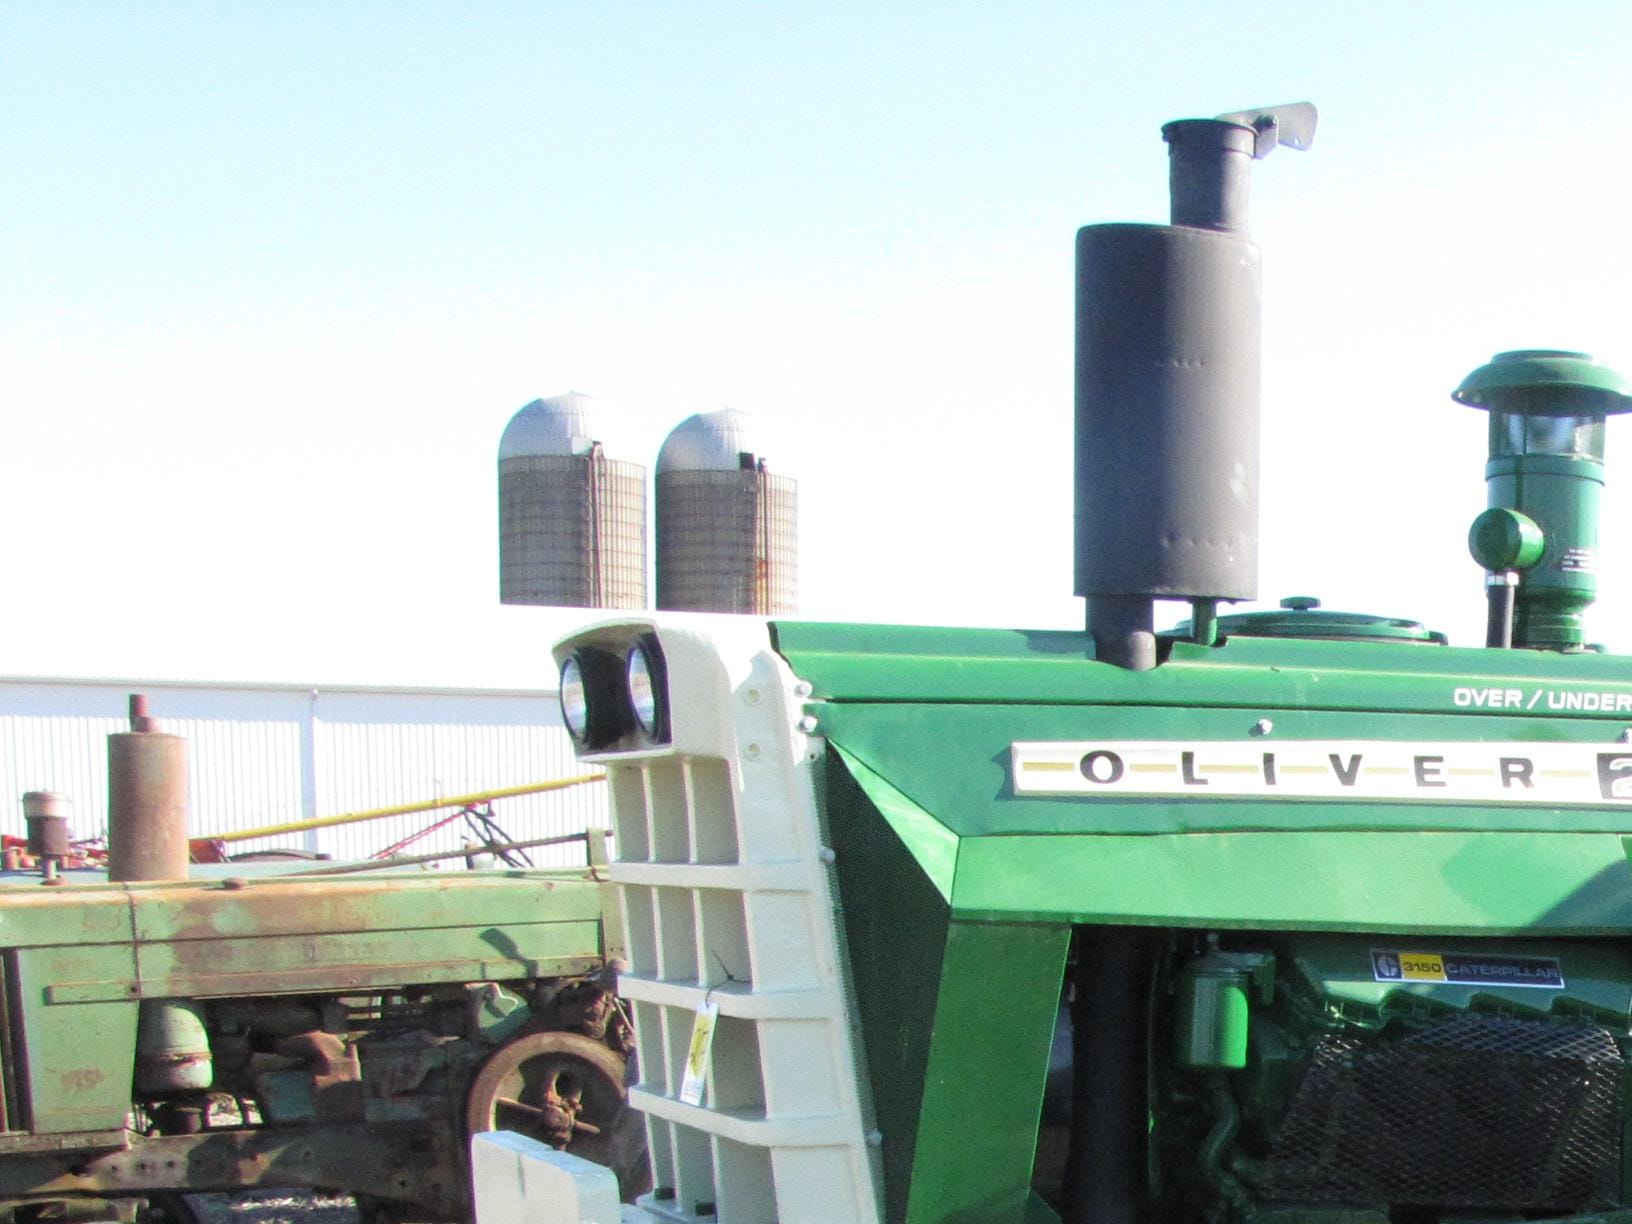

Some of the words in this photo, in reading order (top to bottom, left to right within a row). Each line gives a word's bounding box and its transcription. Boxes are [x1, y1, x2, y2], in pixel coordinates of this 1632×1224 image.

[1079, 749, 1536, 789] OLIVER
[1403, 961, 1442, 973] 3150
[1447, 963, 1562, 978] CATERPILLAR
